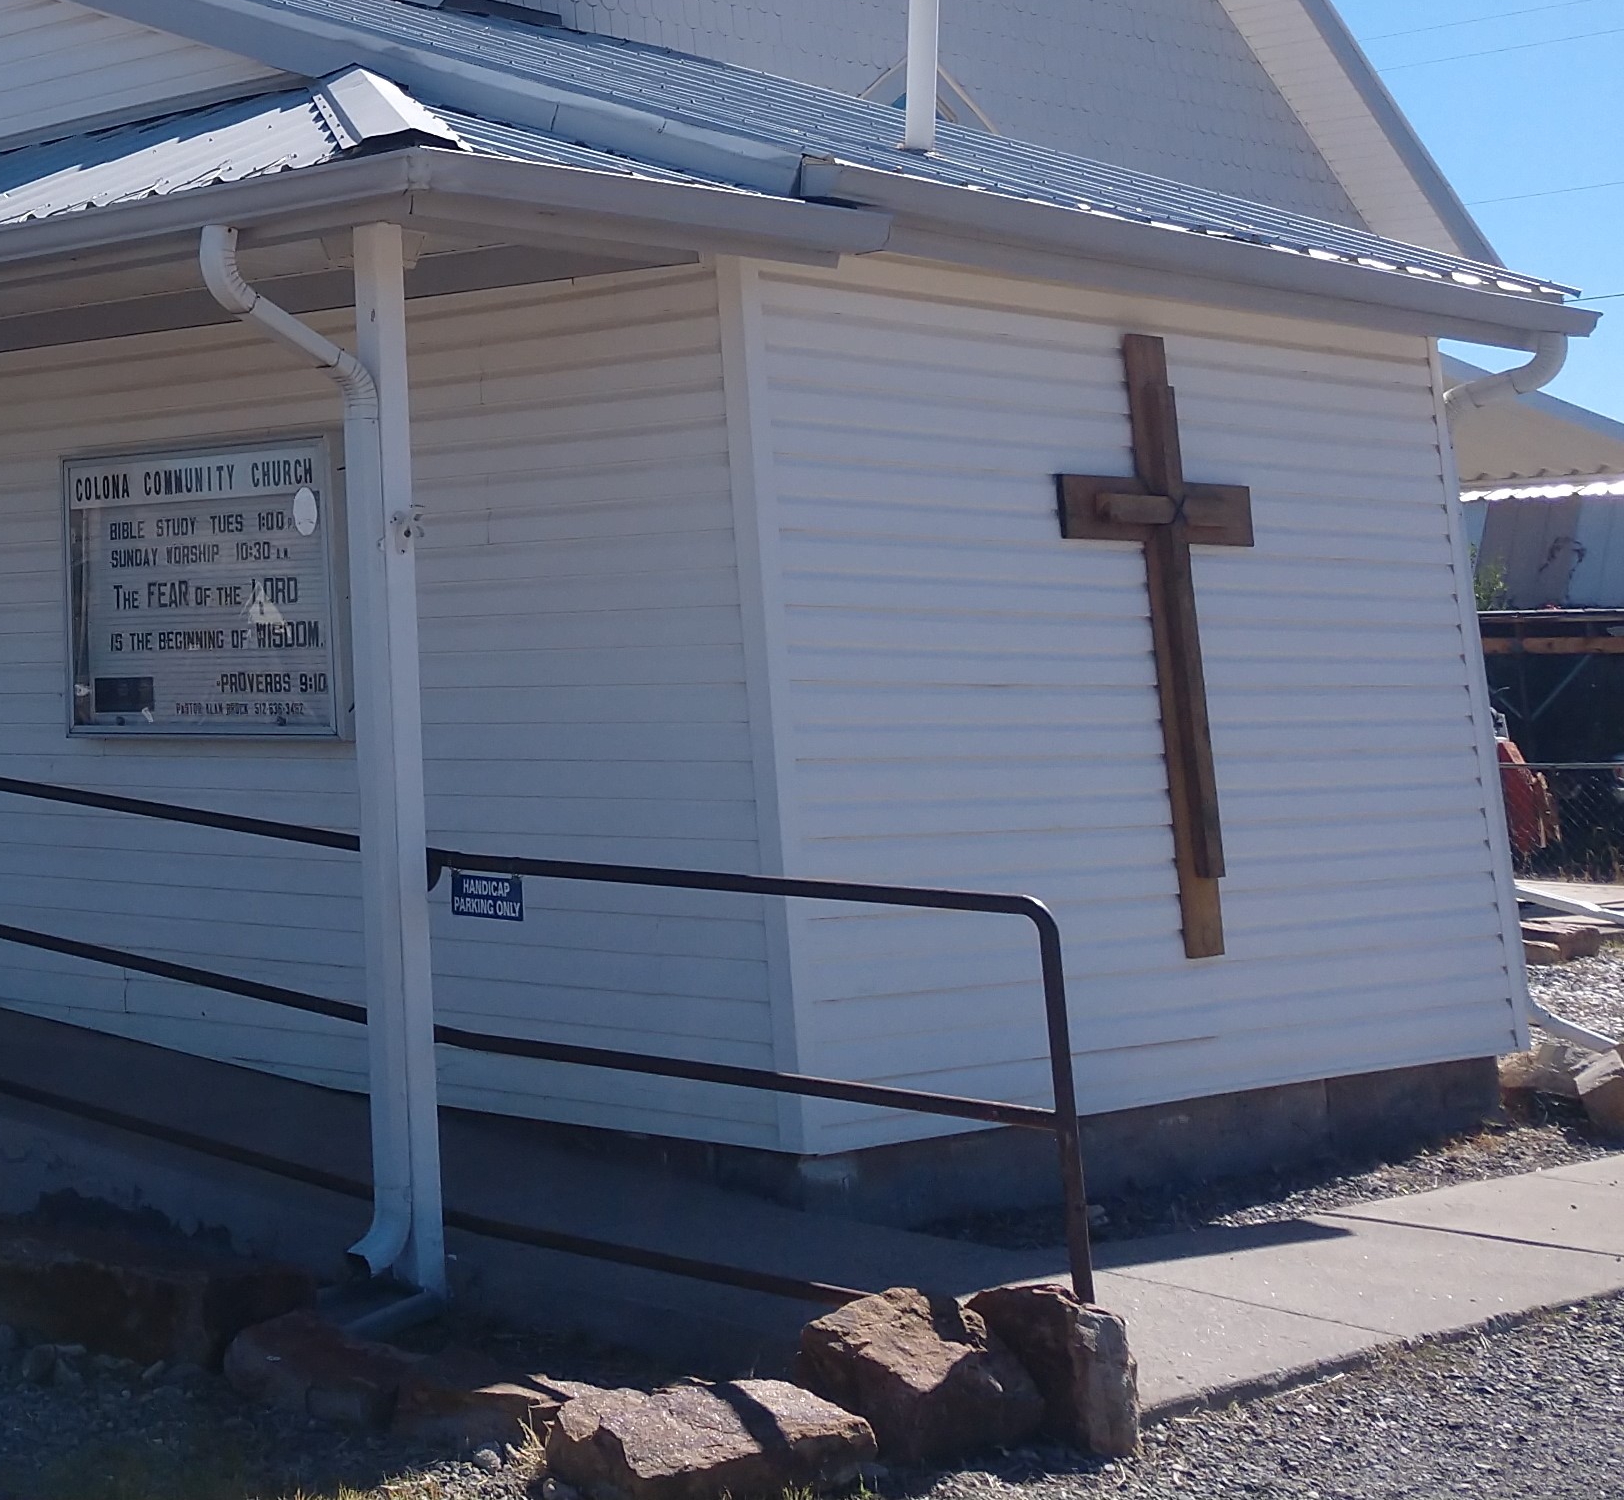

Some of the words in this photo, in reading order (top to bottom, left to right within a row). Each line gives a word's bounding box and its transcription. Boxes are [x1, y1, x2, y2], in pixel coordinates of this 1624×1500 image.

[75, 473, 130, 502] COLONA
[143, 464, 234, 496] COMMUNITY
[251, 457, 313, 488] CHURCH
[109, 520, 145, 540] BIBLE
[156, 517, 196, 537] STUDY
[209, 513, 243, 534] TUES
[257, 511, 284, 531] 1:00
[110, 547, 158, 568] SUNDAY
[166, 544, 219, 564] WORSHIP
[236, 541, 270, 560] 10:30
[147, 580, 189, 608] FEAR
[195, 587, 212, 606] OF
[216, 585, 242, 606] THE
[110, 633, 123, 651] IS
[129, 632, 153, 650] THE
[158, 630, 224, 651] BEGINNING
[231, 629, 249, 649] OF
[299, 672, 327, 693] 9:10
[463, 878, 510, 897] HANDICAP
[454, 896, 494, 915] PARKING
[496, 900, 520, 917] ONLY
